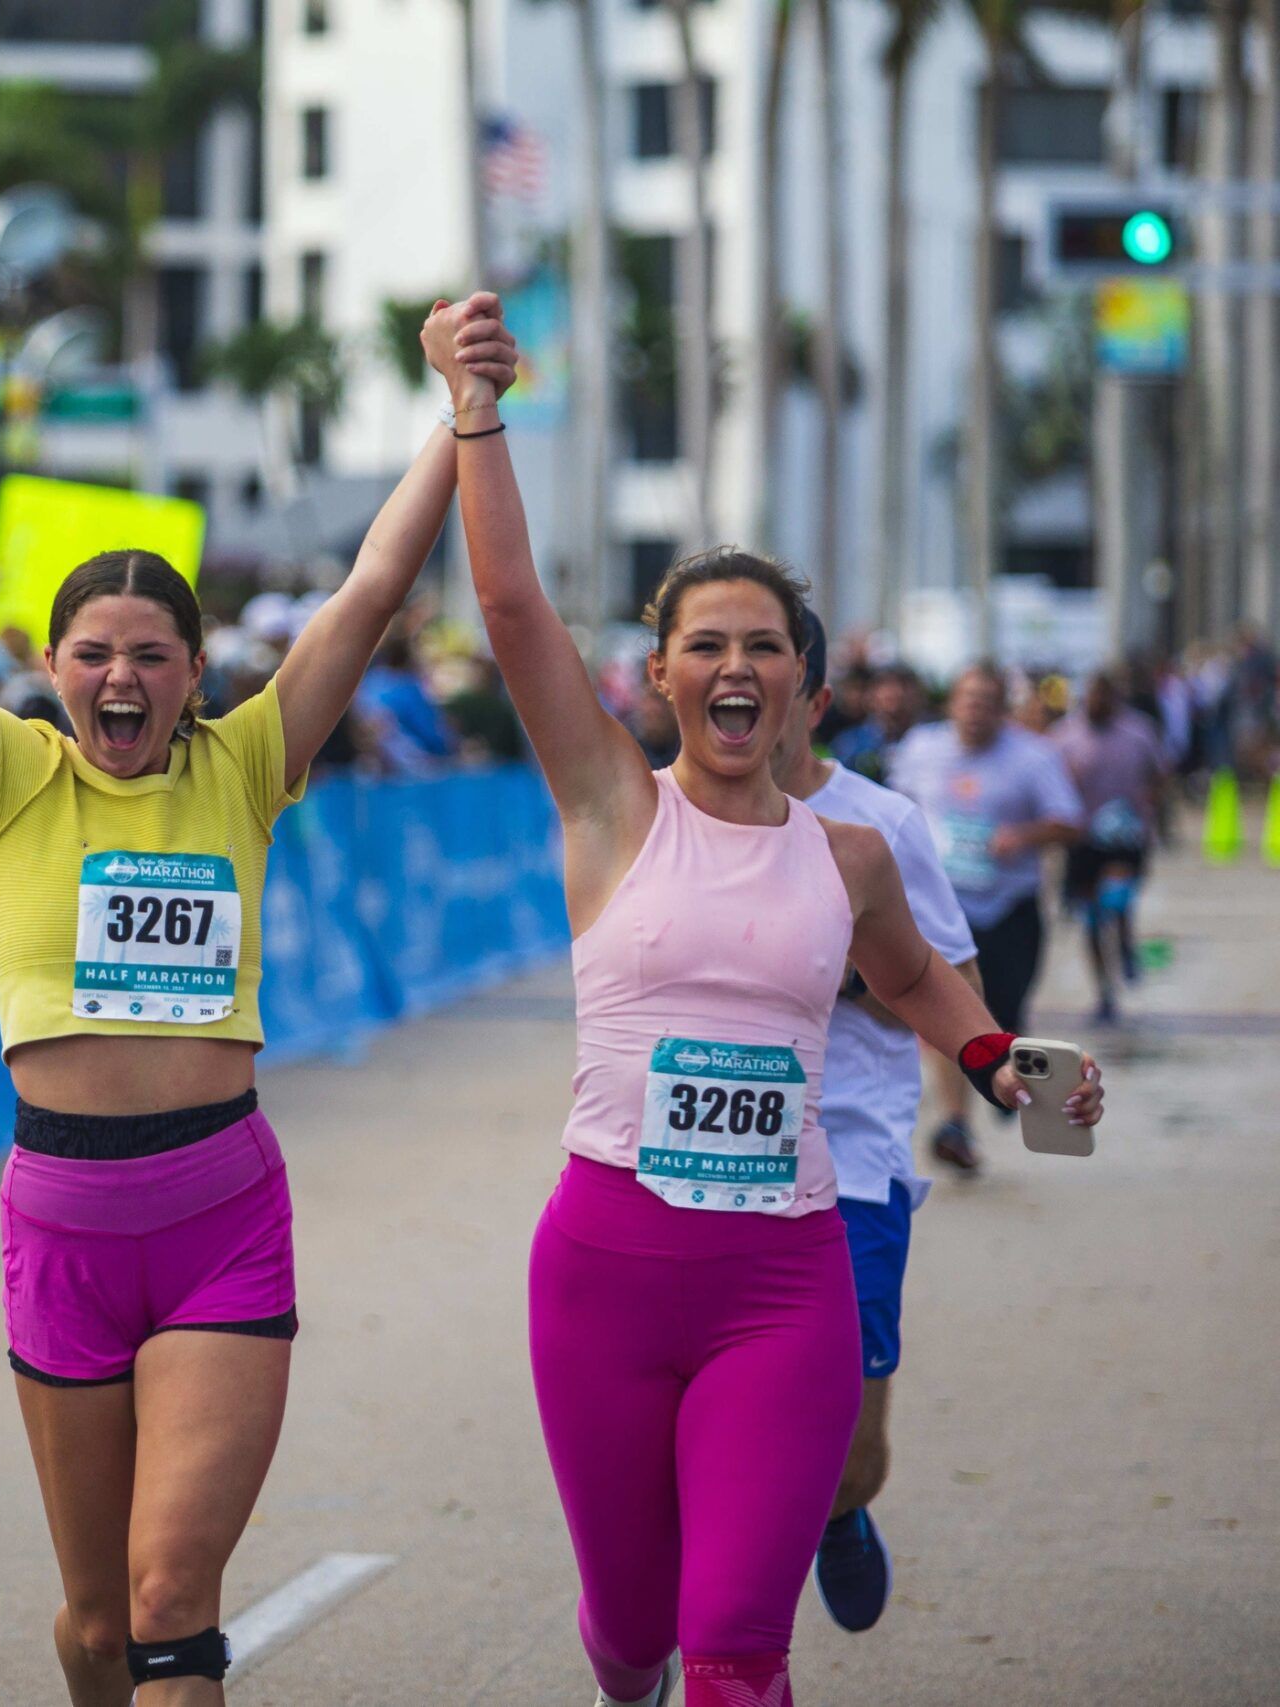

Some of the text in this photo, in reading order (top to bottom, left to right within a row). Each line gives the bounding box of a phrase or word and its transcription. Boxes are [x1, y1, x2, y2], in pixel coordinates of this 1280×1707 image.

[140, 866, 215, 880] MARATHON
[107, 895, 215, 946] 3267
[85, 968, 226, 985] HALF MARATHON
[711, 1056, 789, 1071] MARATHON
[669, 1083, 785, 1136] 3268
[649, 1154, 789, 1173] HALF MARATHON
